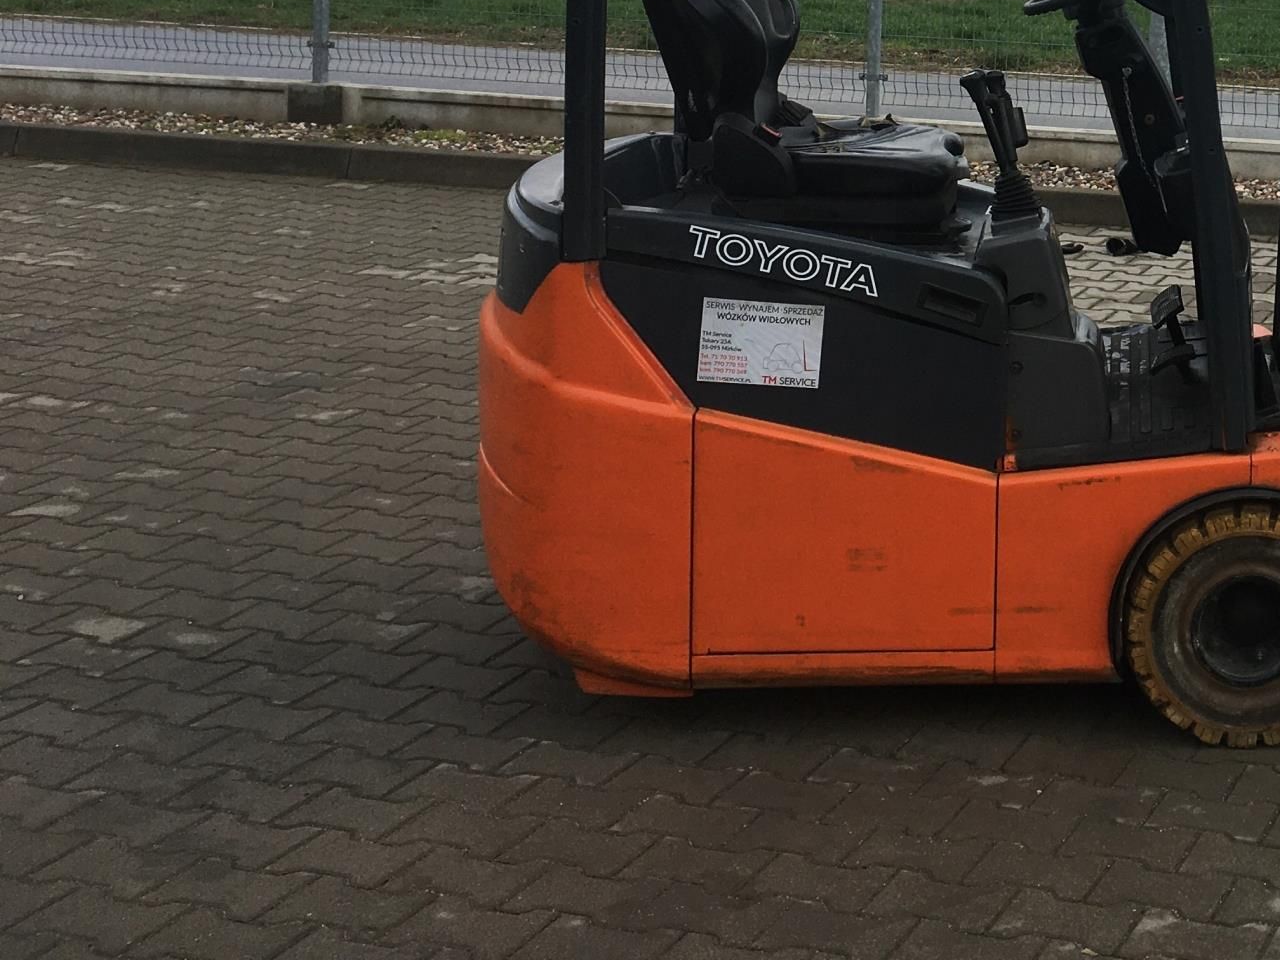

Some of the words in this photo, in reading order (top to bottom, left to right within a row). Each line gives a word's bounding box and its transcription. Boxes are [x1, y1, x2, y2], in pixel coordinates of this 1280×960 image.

[689, 225, 879, 297] TOYOTA
[705, 301, 735, 310] SERWIS
[740, 304, 779, 314] WYNAJEM
[717, 312, 756, 322] WÓZKÓW
[759, 316, 811, 326] WIDŁOWYCH
[762, 376, 777, 384] TM
[779, 377, 816, 387] SERVICE
